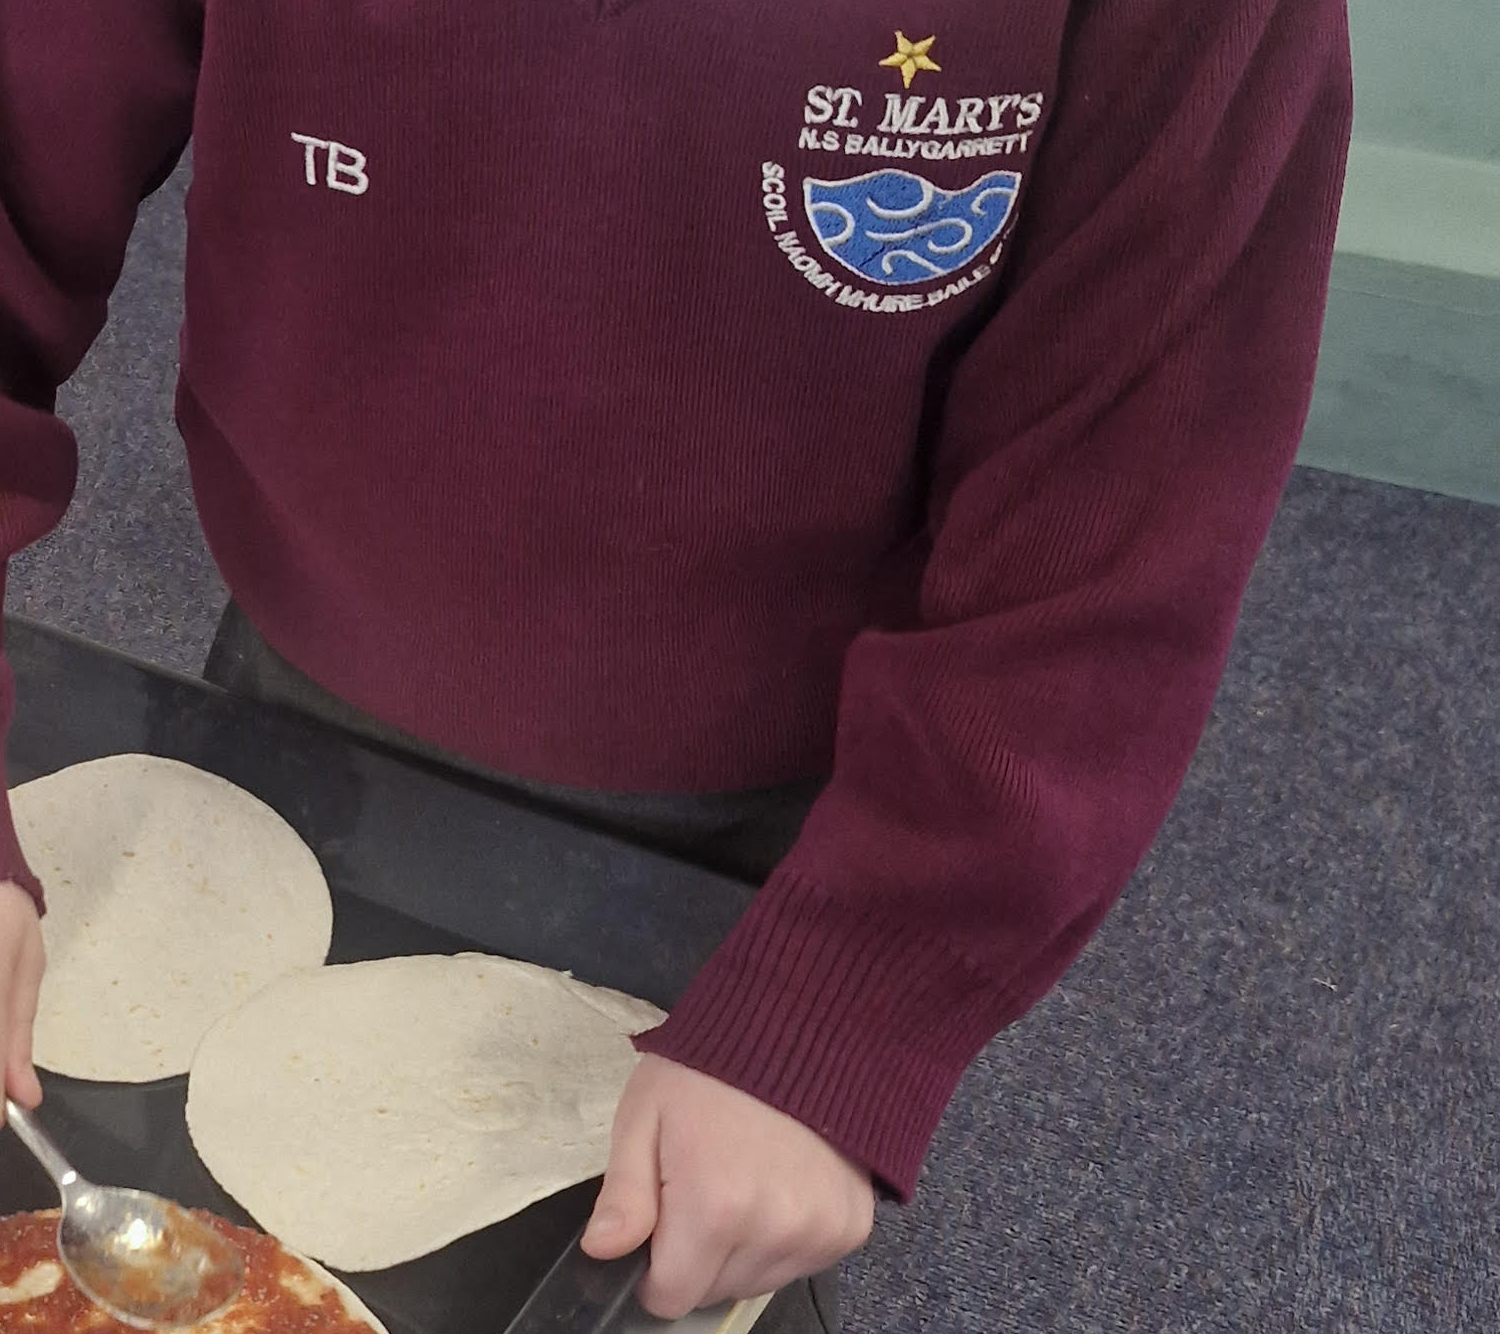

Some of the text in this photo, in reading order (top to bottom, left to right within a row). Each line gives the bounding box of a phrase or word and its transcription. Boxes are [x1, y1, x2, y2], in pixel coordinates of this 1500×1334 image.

[804, 85, 1044, 135] ST. MARY'S
[290, 132, 369, 195] TB
[761, 161, 788, 232] SCOIL
